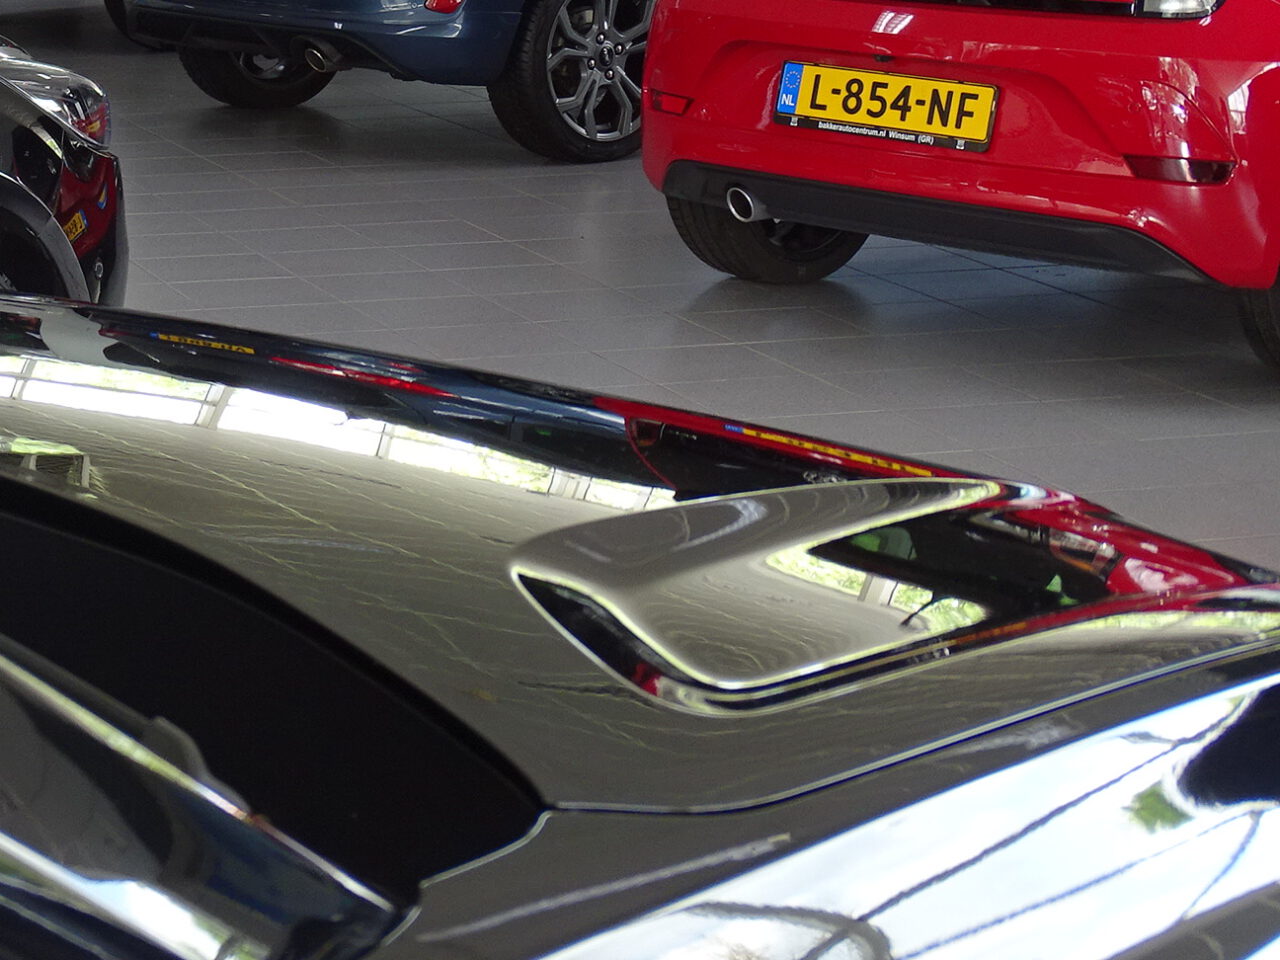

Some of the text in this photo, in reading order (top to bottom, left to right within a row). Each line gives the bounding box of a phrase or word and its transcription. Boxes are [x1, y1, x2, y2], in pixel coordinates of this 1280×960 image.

[780, 93, 795, 107] NL
[809, 74, 979, 129] L-854-NF
[818, 121, 934, 145] bakkerautocentrum.nl Winsum (GR)
